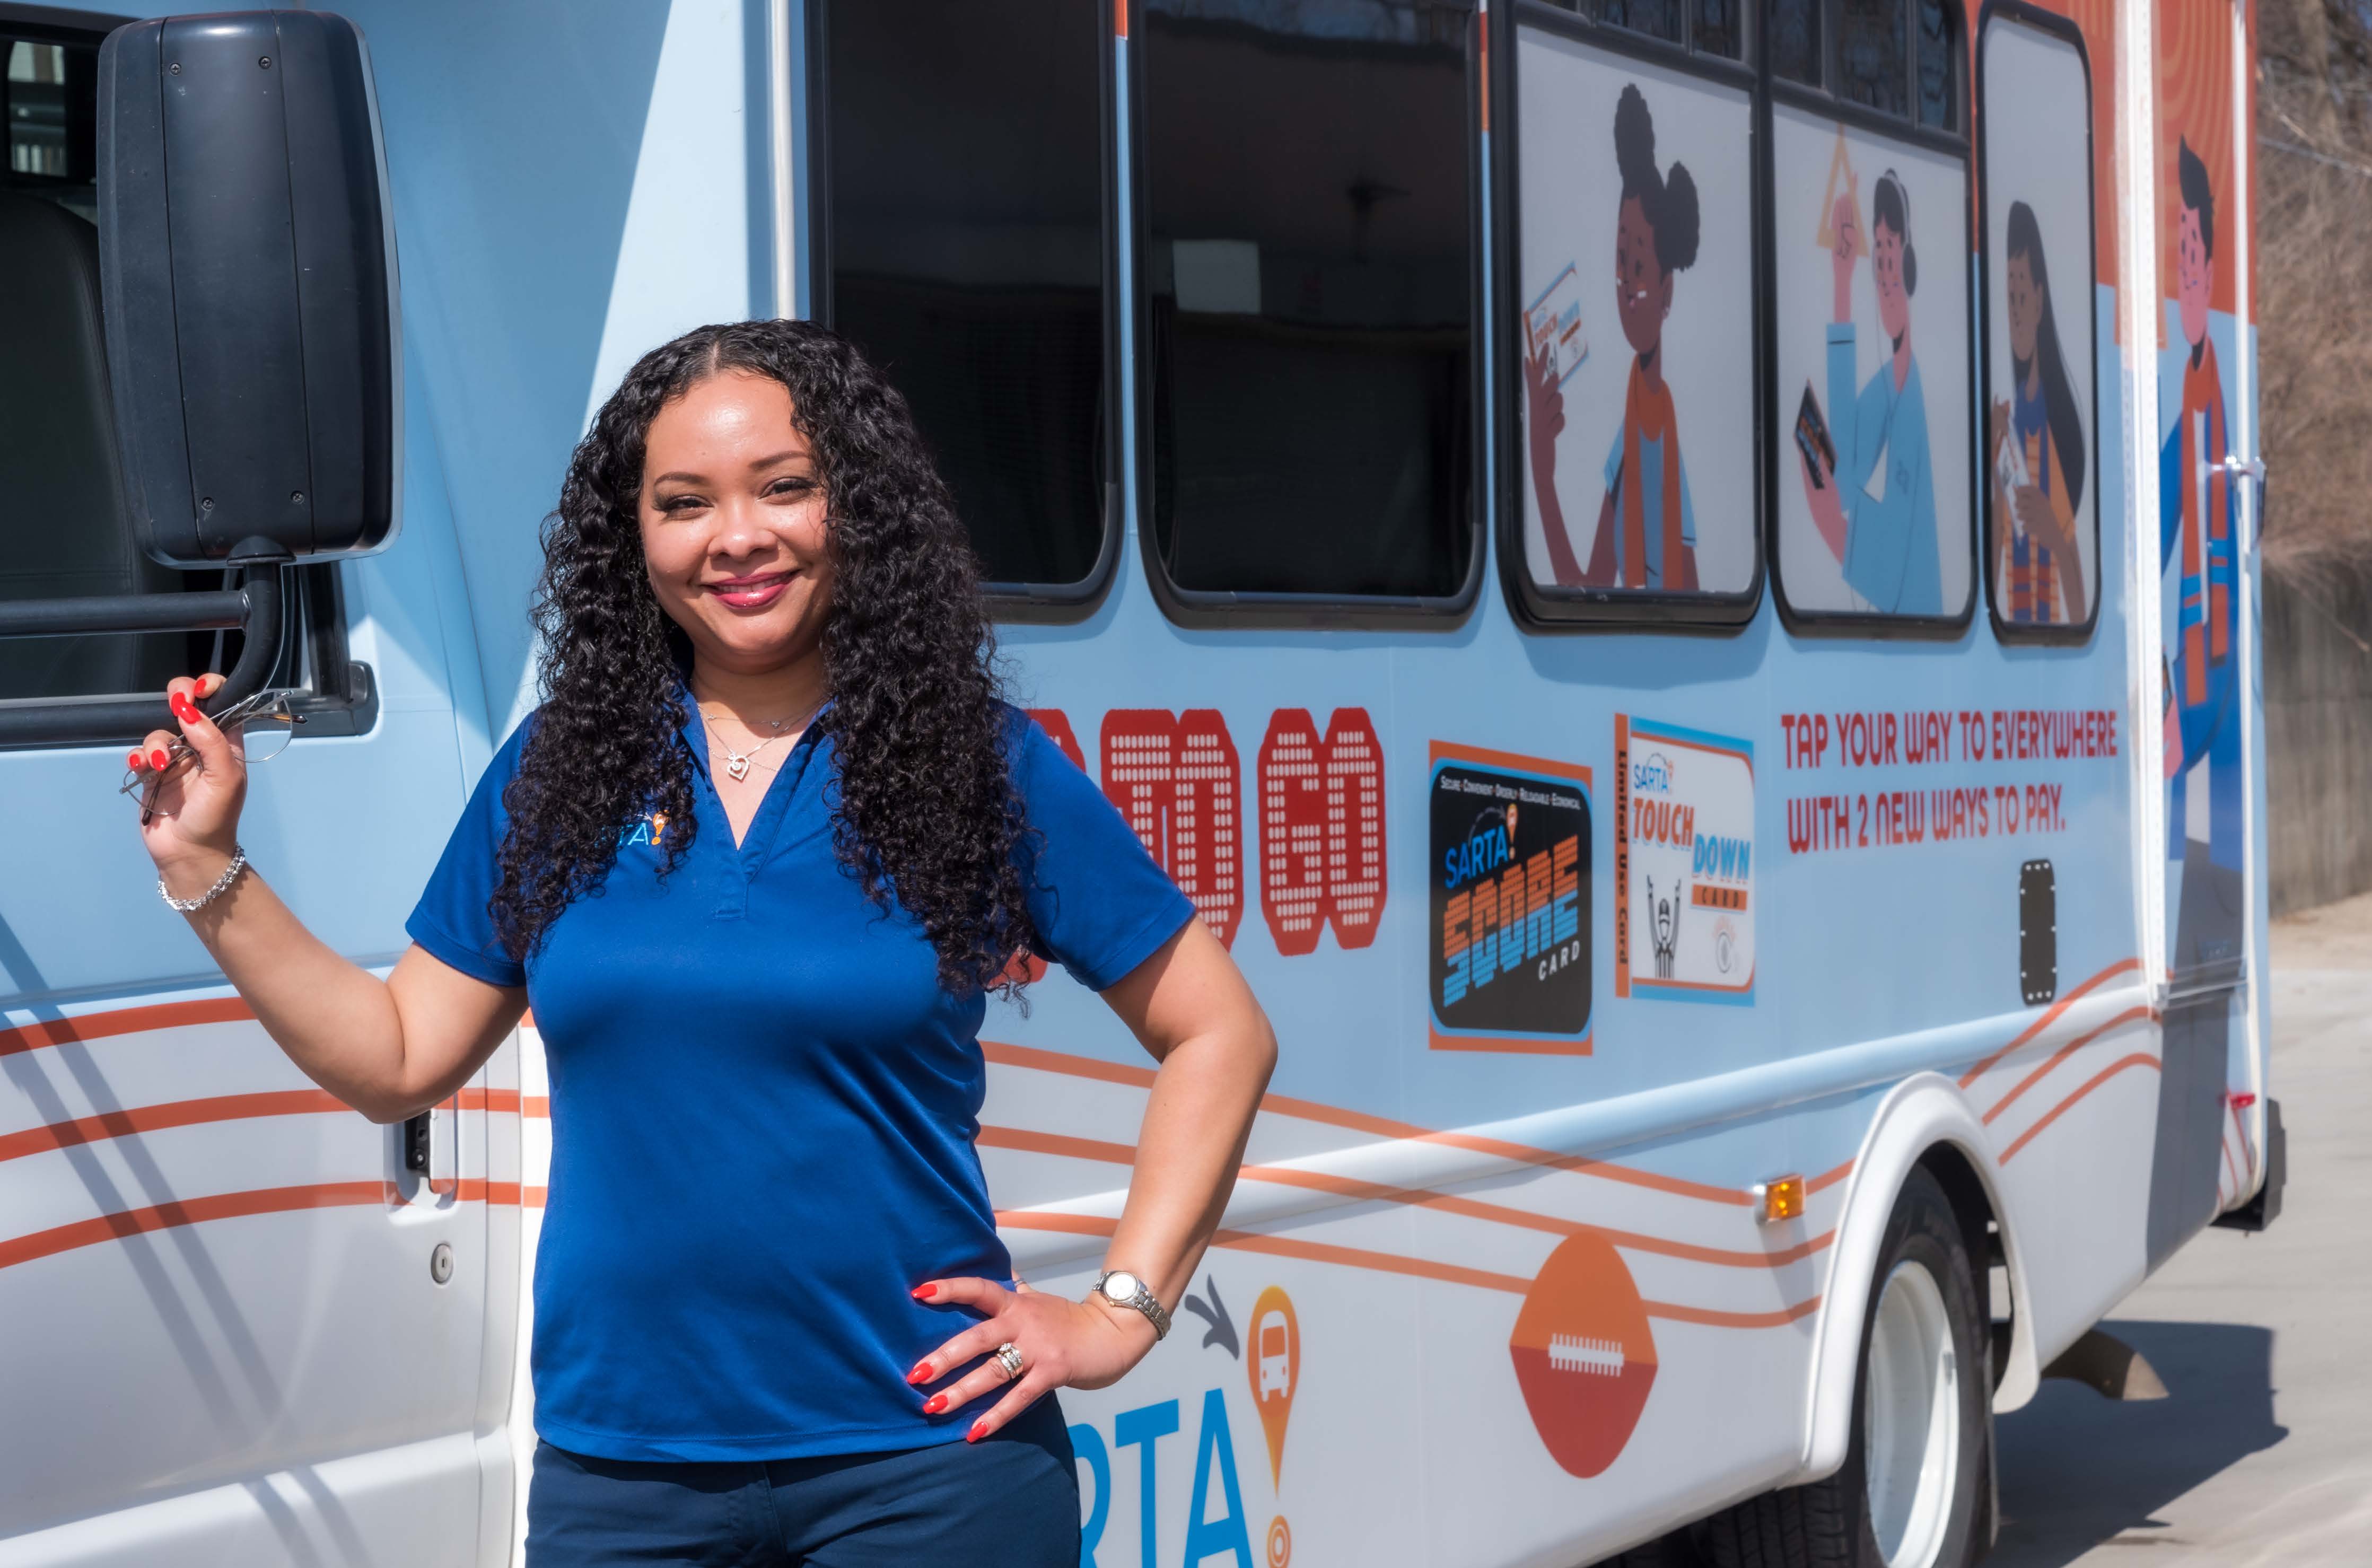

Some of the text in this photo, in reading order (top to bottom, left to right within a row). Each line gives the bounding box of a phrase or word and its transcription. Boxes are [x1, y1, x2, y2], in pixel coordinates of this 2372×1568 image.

[1781, 710, 2118, 769] TAP YOUR WAY TO EVERYWHERE
[1633, 763, 1669, 794] SARTA
[1262, 719, 1383, 945] GO
[1633, 797, 1695, 848] TOUCH
[1787, 783, 2066, 854] WITH 2 NEW WAYS TO PAY.
[1445, 824, 1509, 889] SARTA
[1618, 750, 1628, 965] Limited Use Card
[1693, 833, 1750, 881] DOWN
[1538, 940, 1580, 982] CARD
[1067, 1388, 1255, 1568] RTA
